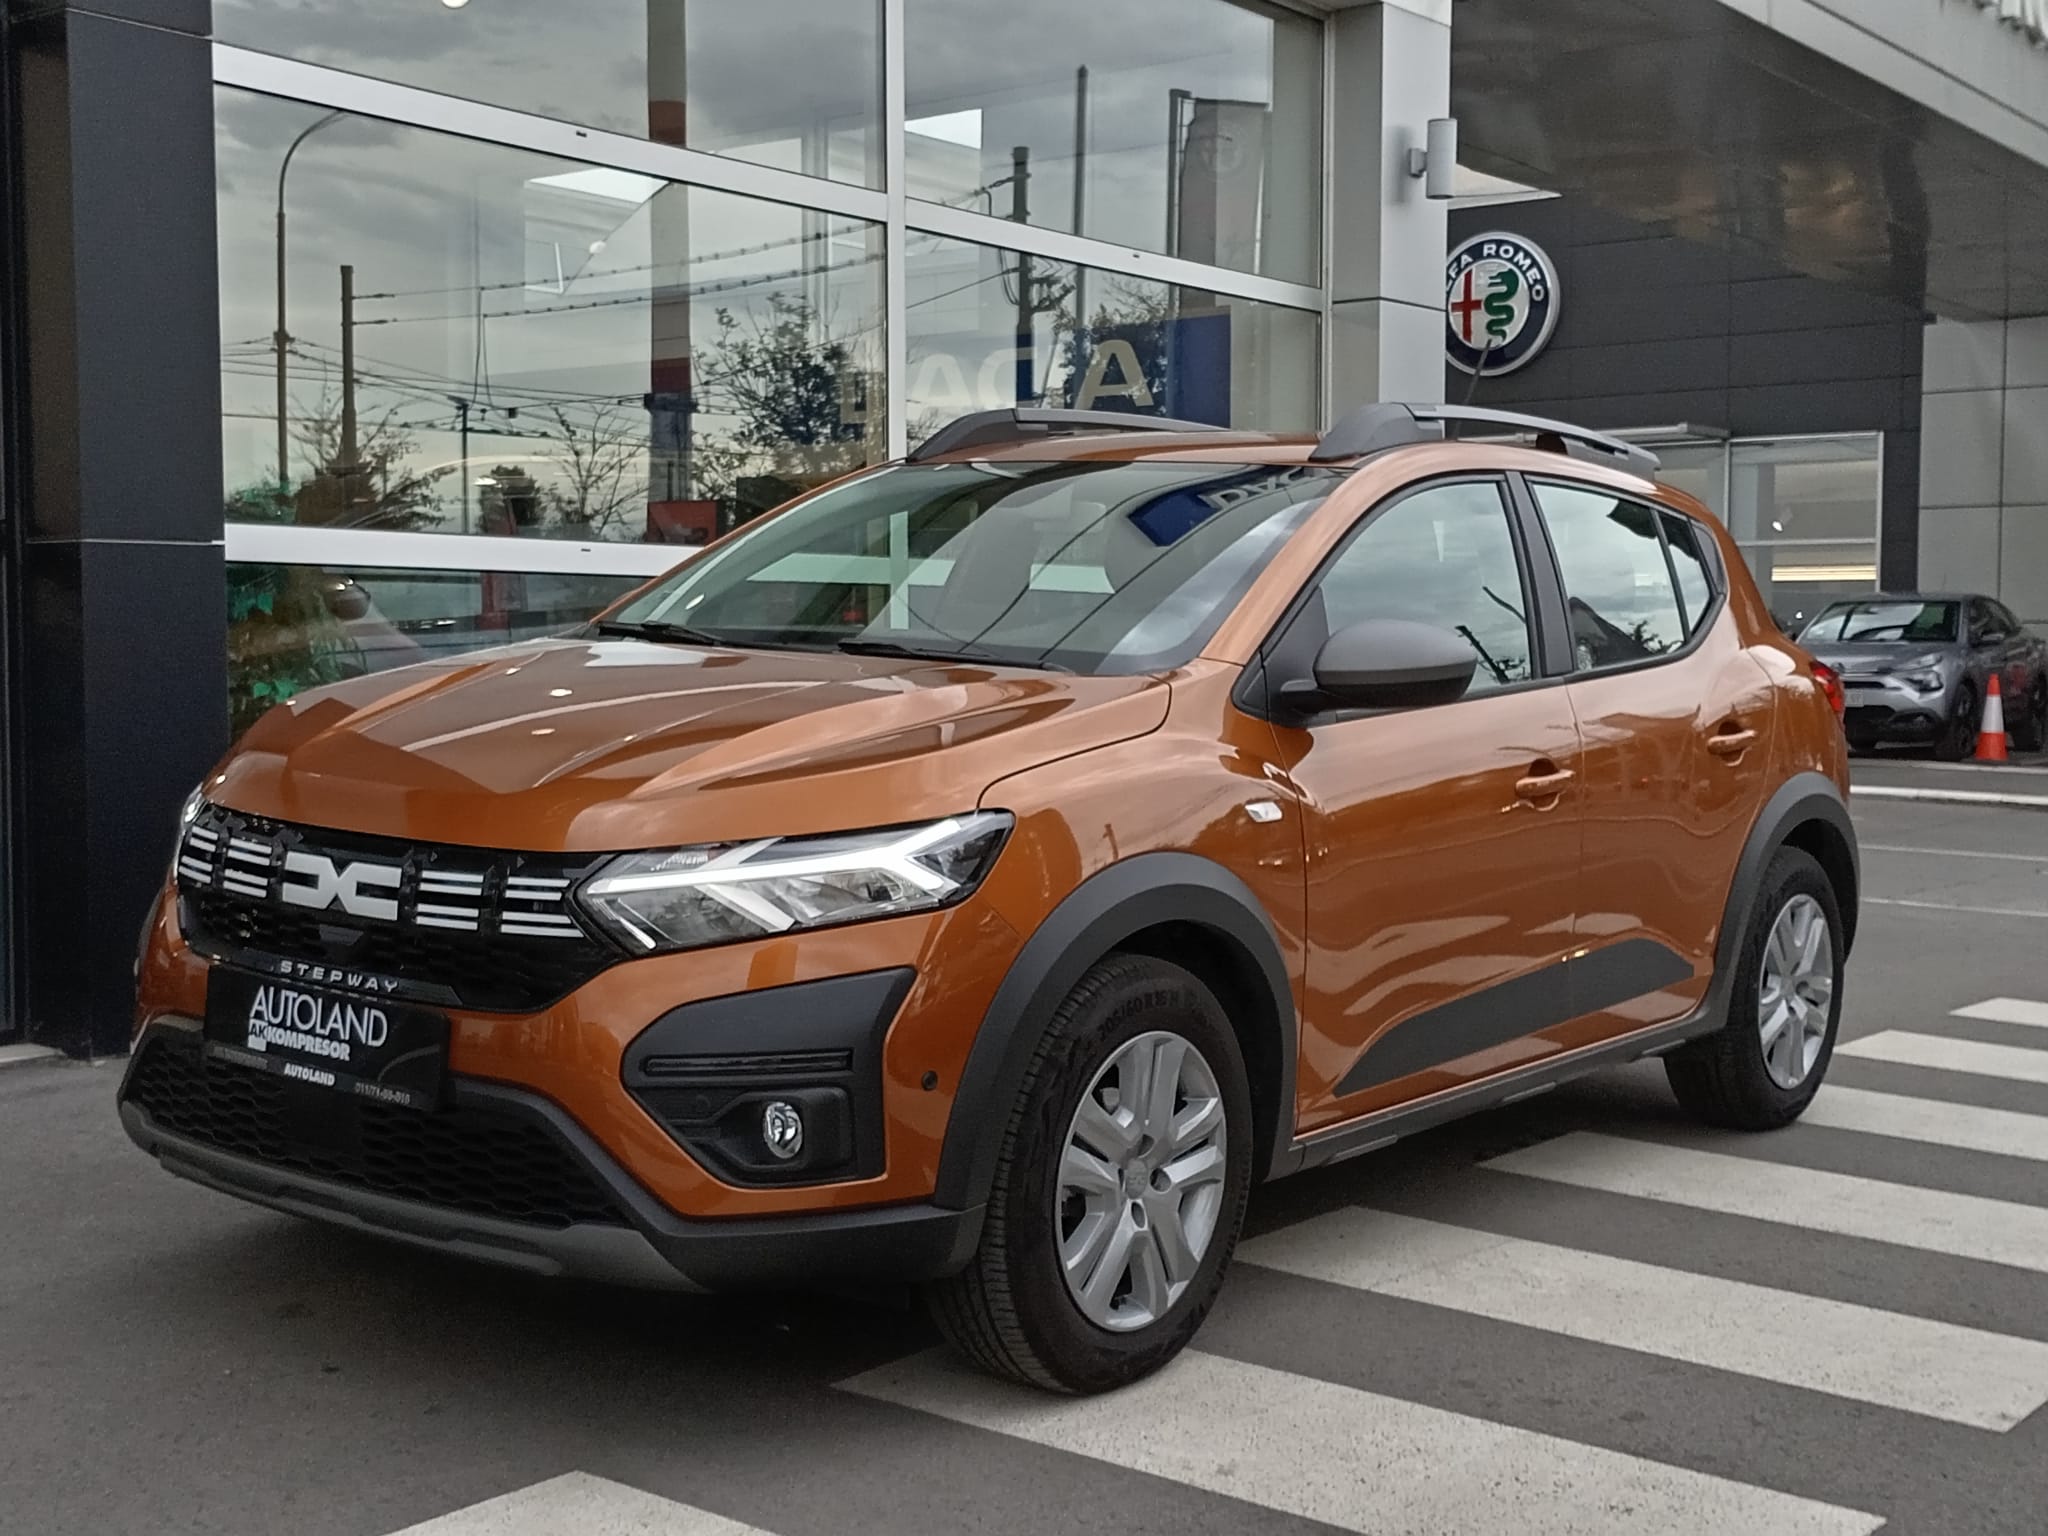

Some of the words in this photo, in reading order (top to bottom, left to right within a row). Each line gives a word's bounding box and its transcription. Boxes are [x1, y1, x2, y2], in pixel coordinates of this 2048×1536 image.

[1447, 254, 1474, 293] FA
[1483, 244, 1545, 302] ROMEO
[281, 960, 398, 993] STEPWAY
[250, 985, 388, 1047] AUTOLAND
[284, 1063, 335, 1086] AUTOLAND
